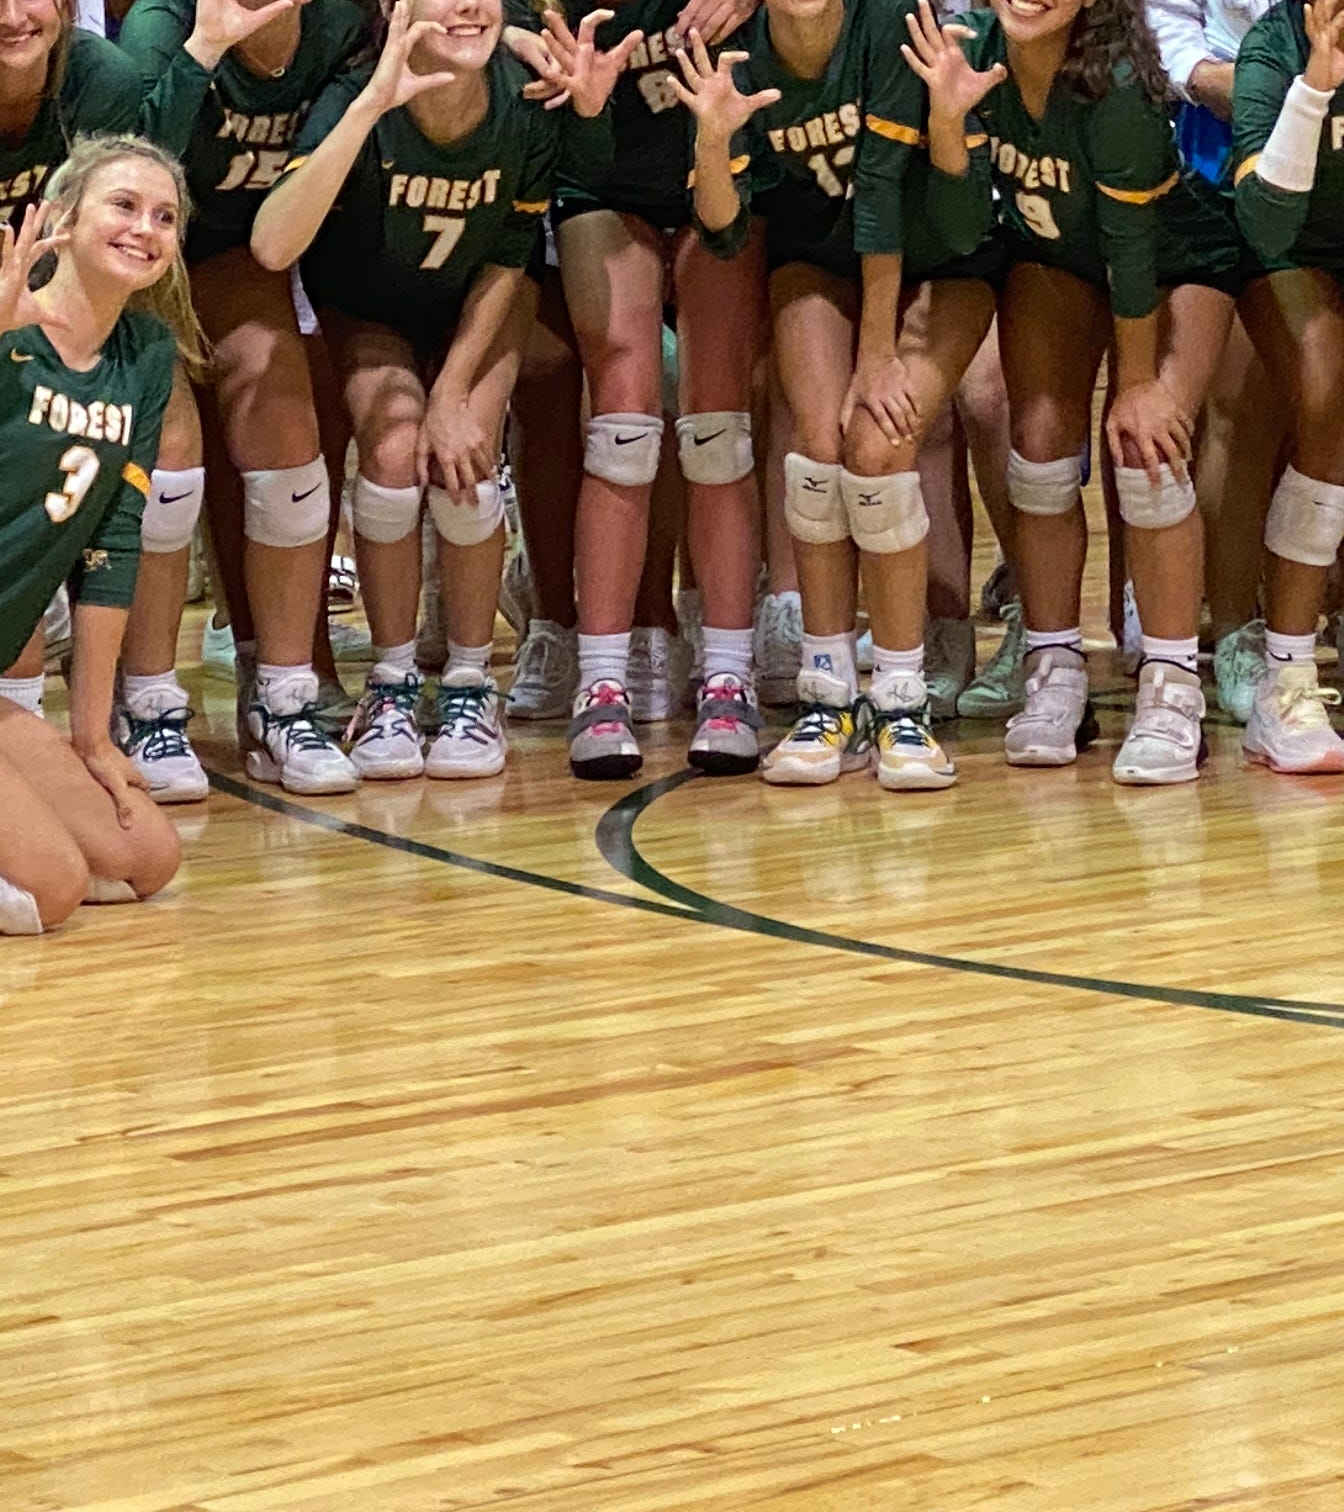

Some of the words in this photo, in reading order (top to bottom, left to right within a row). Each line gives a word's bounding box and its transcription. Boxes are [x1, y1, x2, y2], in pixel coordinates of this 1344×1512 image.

[768, 96, 862, 153] FORES
[388, 169, 501, 211] FOREST
[419, 215, 467, 270] 7
[28, 385, 132, 446] FOREST
[45, 444, 100, 524] 3
